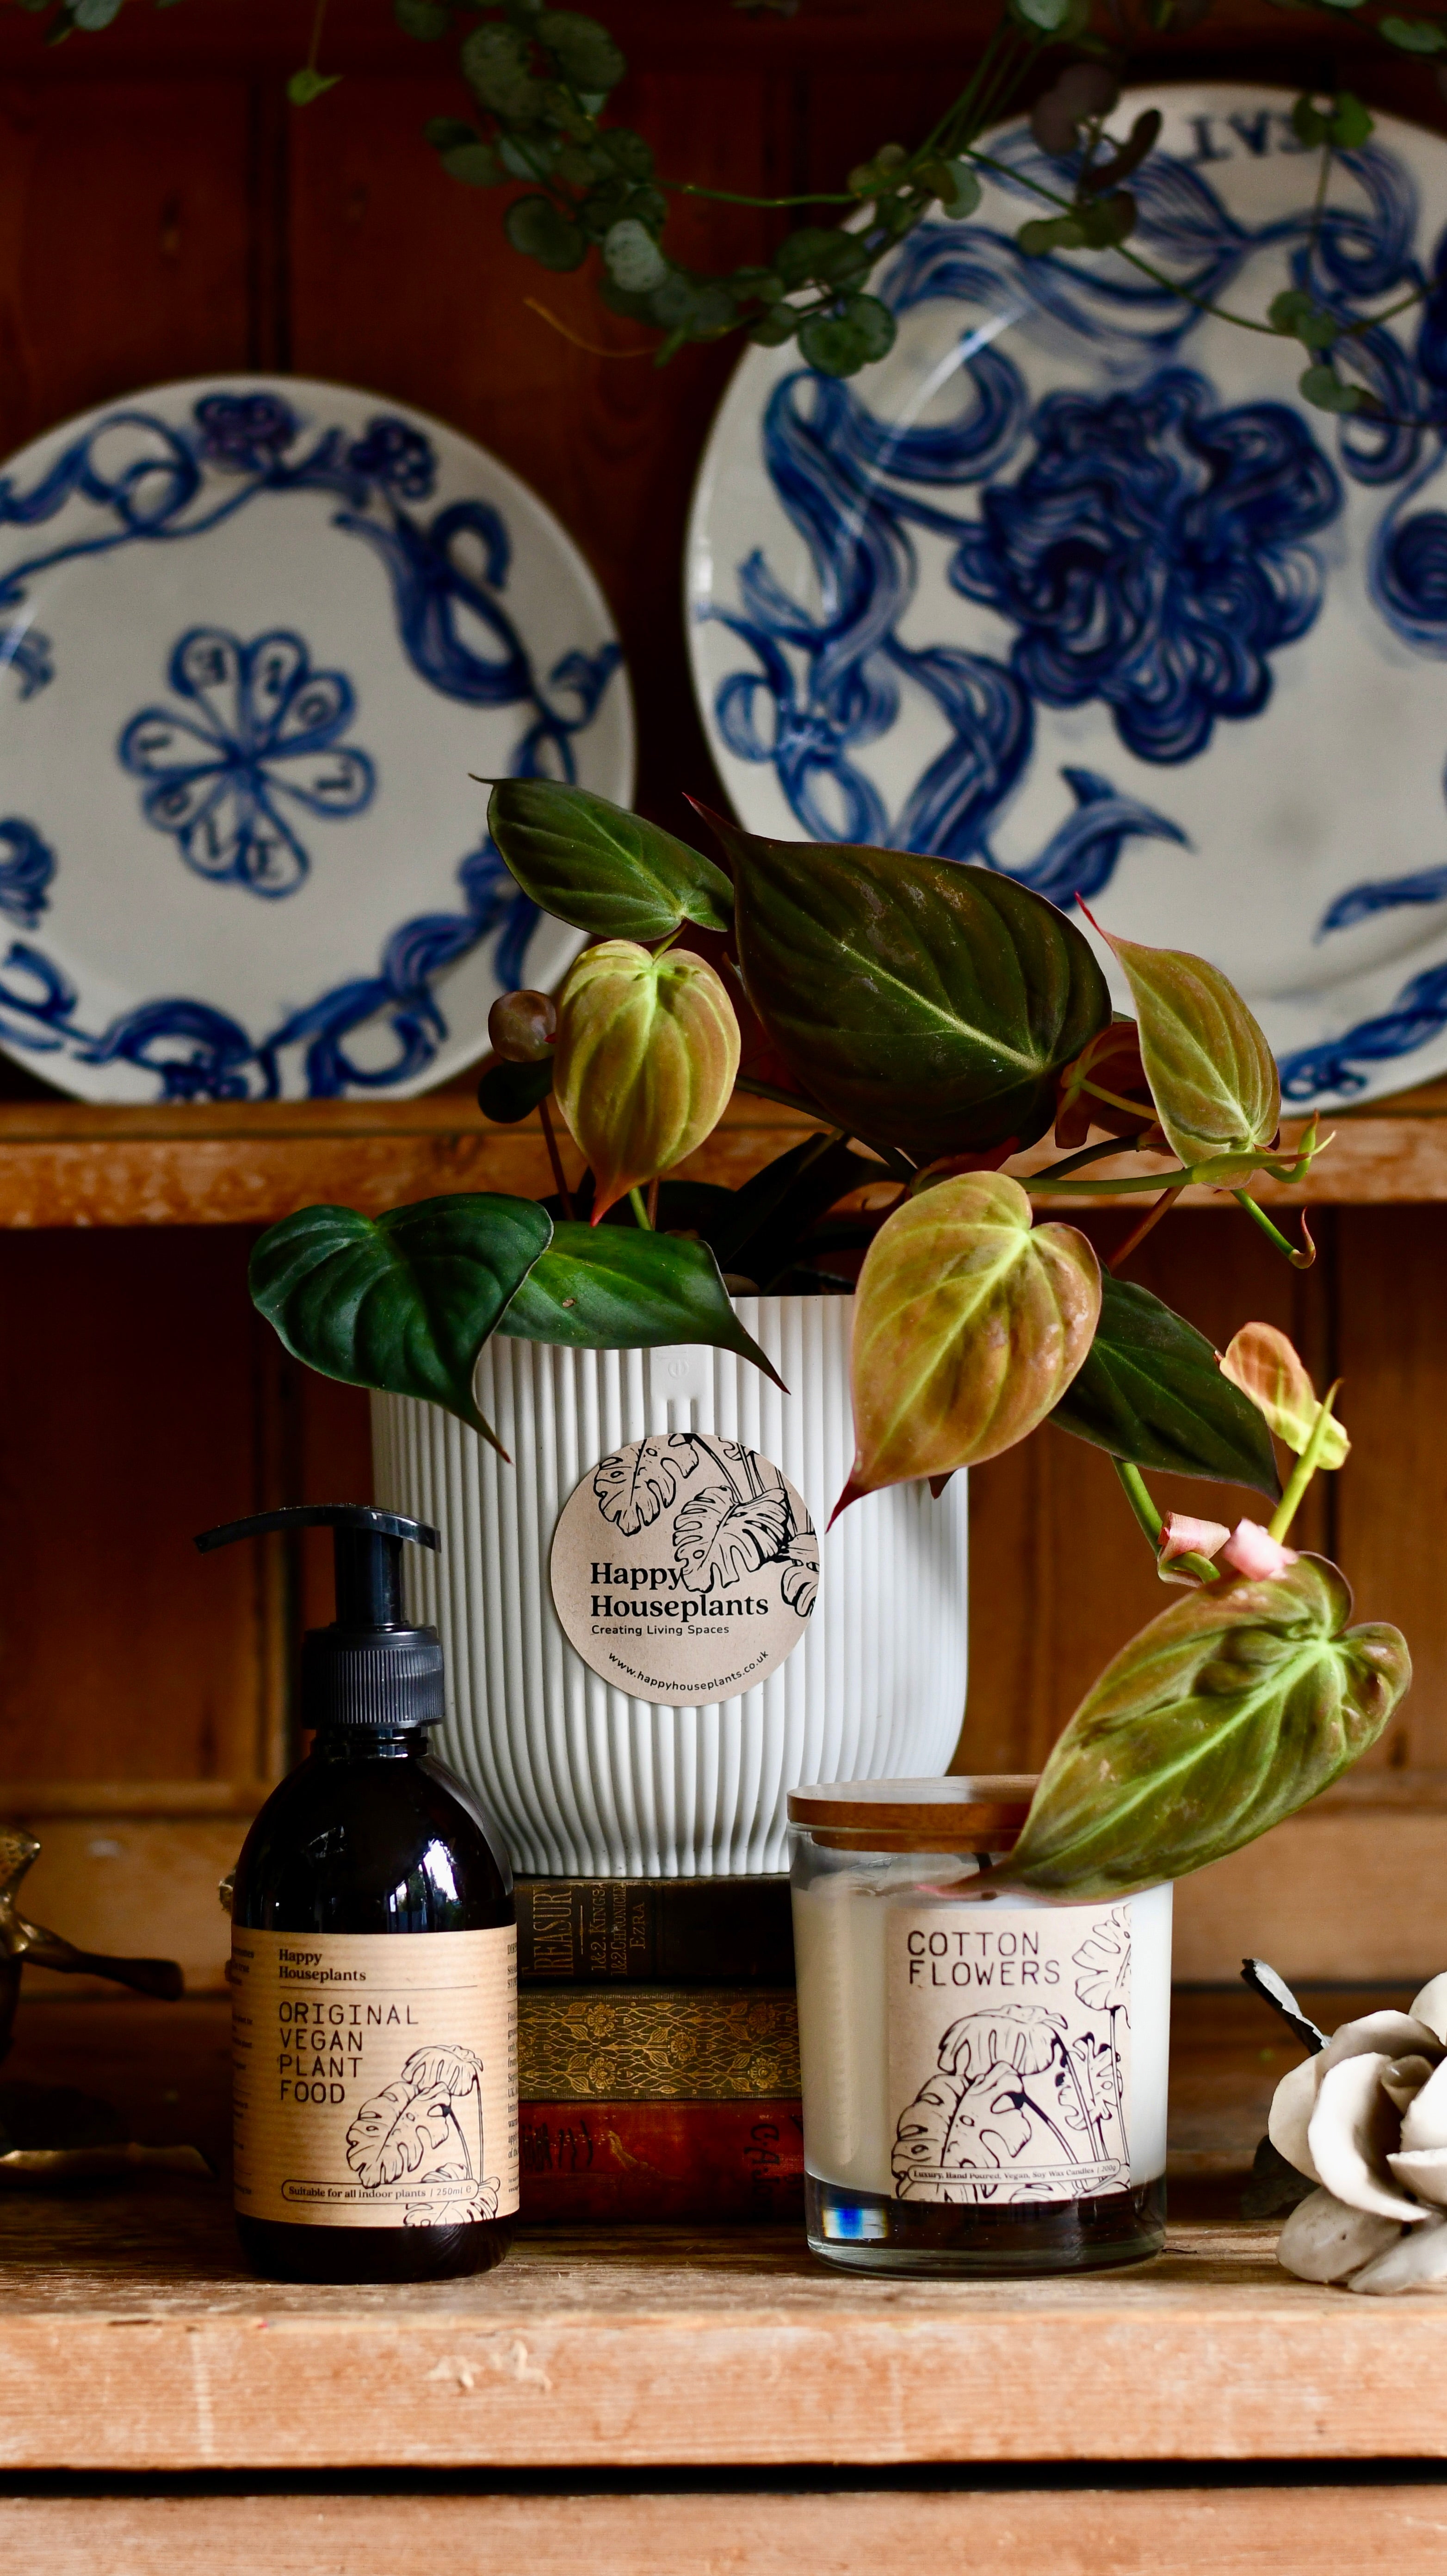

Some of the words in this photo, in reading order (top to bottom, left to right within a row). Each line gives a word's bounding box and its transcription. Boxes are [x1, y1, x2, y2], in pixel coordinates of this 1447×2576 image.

[590, 1562, 682, 1591] Happy
[590, 1594, 769, 1622] Houseplants
[591, 1625, 643, 1636] Creating
[647, 1625, 683, 1636] Living
[687, 1625, 730, 1635] Spaces
[608, 1650, 769, 1691] www.happyhouseplants.co.uk
[630, 1902, 645, 1949] EZRA
[907, 1930, 1039, 1957] COTTON
[278, 1949, 322, 1965] Happy
[278, 1965, 366, 1983] Houseplants
[909, 1960, 1060, 1986] FLOWERS
[279, 2001, 419, 2025] ORIGINAL
[280, 2028, 363, 2051] VEGAN
[280, 2054, 363, 2078] PLANT
[280, 2079, 346, 2104] FOOD
[914, 2170, 944, 2179] Luxury,
[1066, 2167, 1094, 2175] Candles
[289, 2186, 325, 2197] Suitable
[328, 2188, 343, 2197] for
[345, 2189, 356, 2198] all
[359, 2189, 393, 2198] indoor
[396, 2189, 426, 2199] plants
[436, 2187, 463, 2196] 250ml
